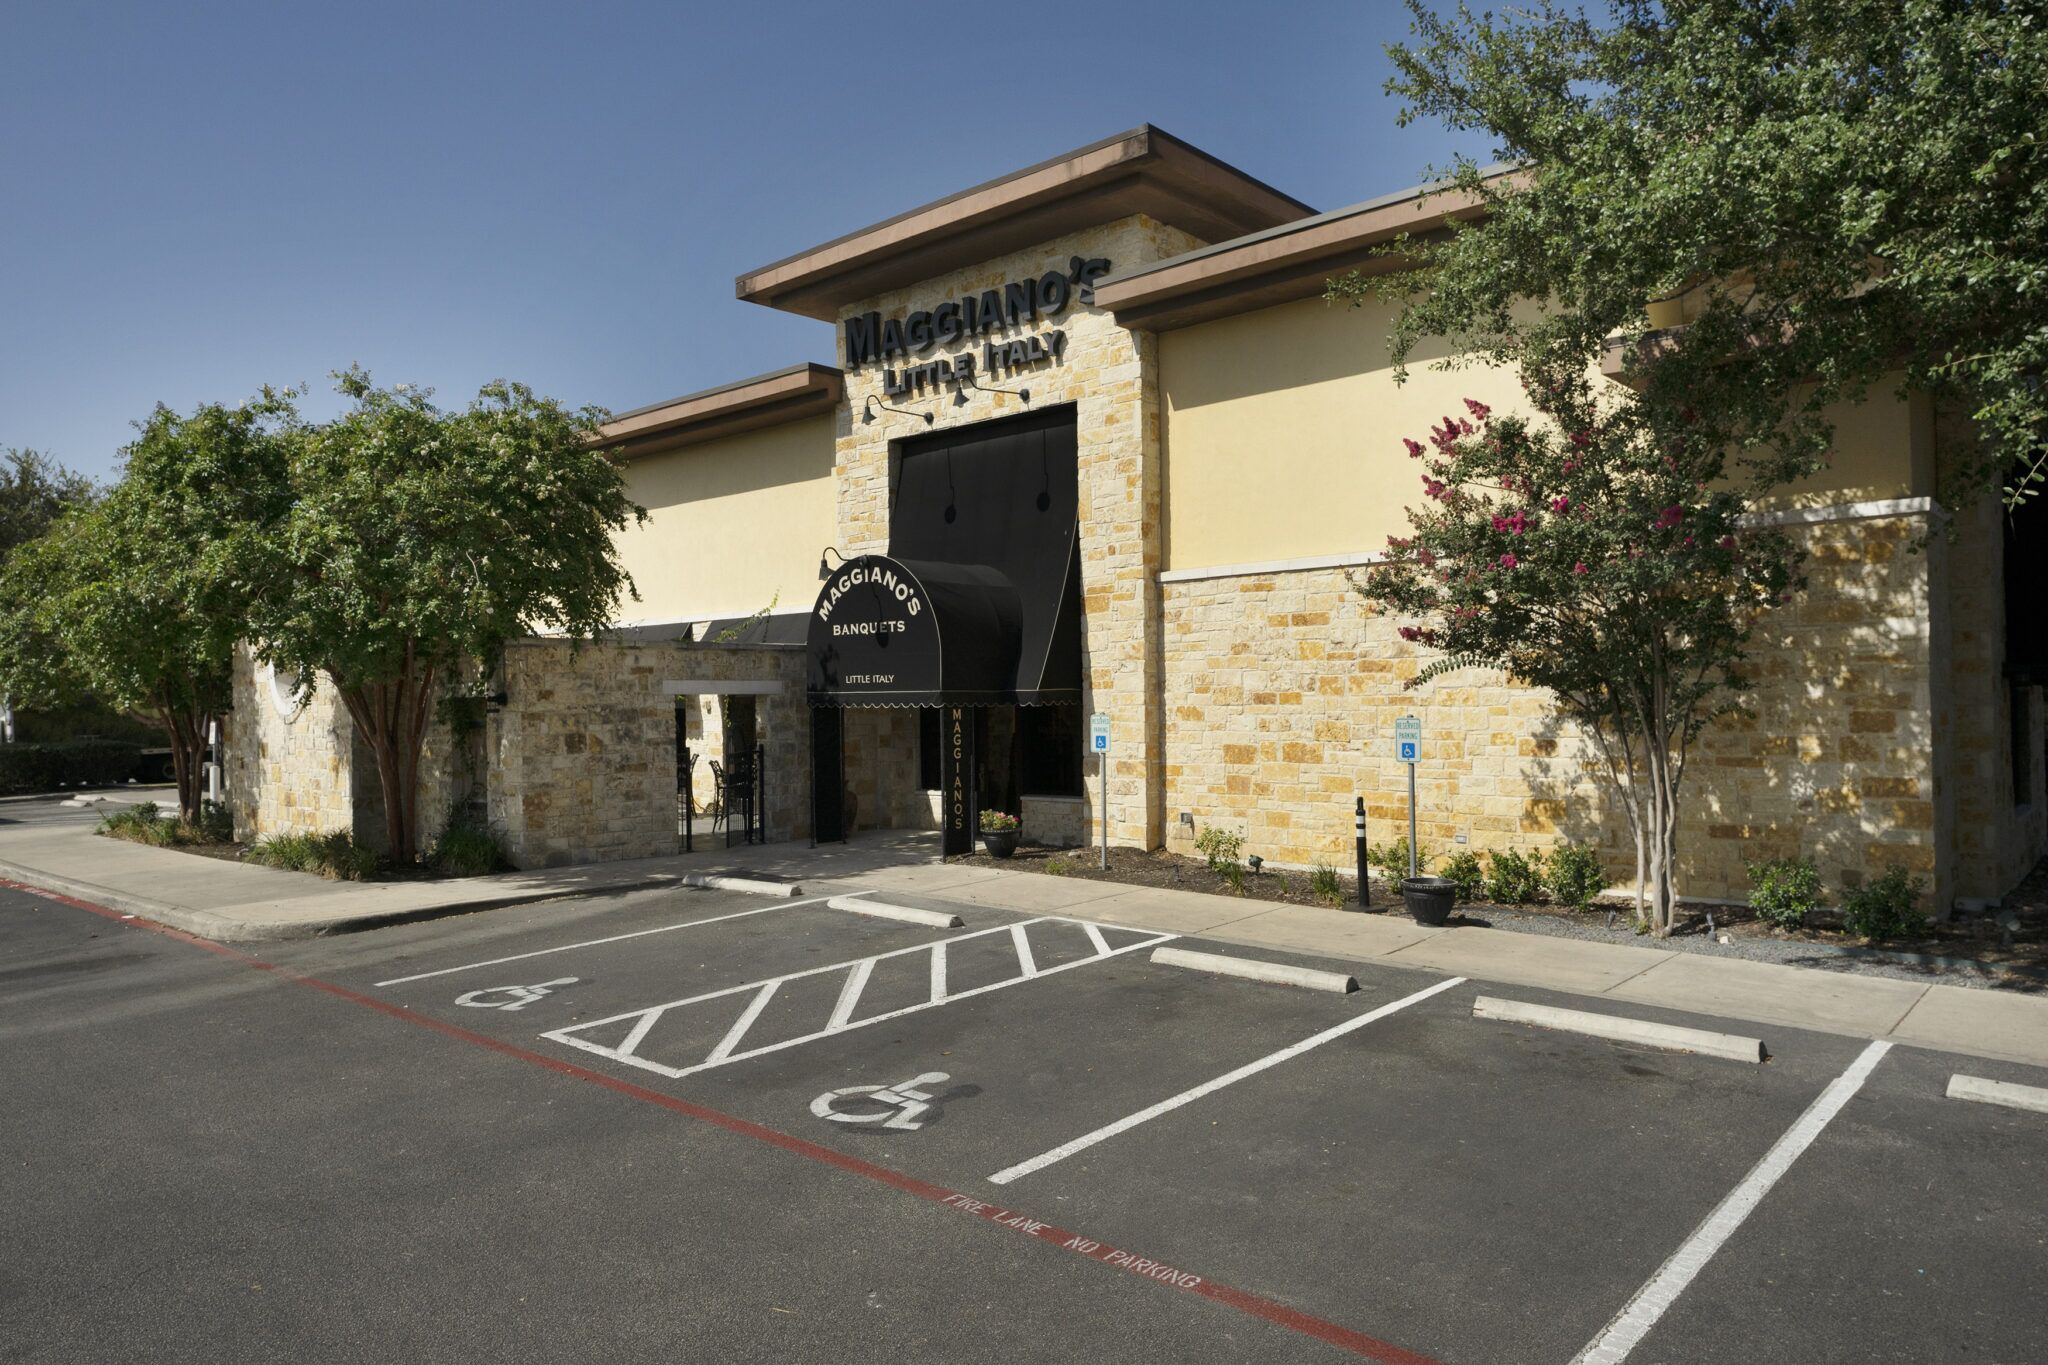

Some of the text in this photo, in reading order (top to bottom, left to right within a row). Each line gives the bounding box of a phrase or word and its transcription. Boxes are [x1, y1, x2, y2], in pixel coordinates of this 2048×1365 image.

[844, 255, 1112, 370] MAGGIANO'S
[883, 329, 1066, 395] LITTLE ITALY
[818, 566, 922, 622] MAGGIANO'S
[832, 620, 906, 636] BANQUETS
[845, 674, 895, 684] LITTLE ITALY
[942, 1193, 1202, 1289] FIRE LANE NO PARKING
